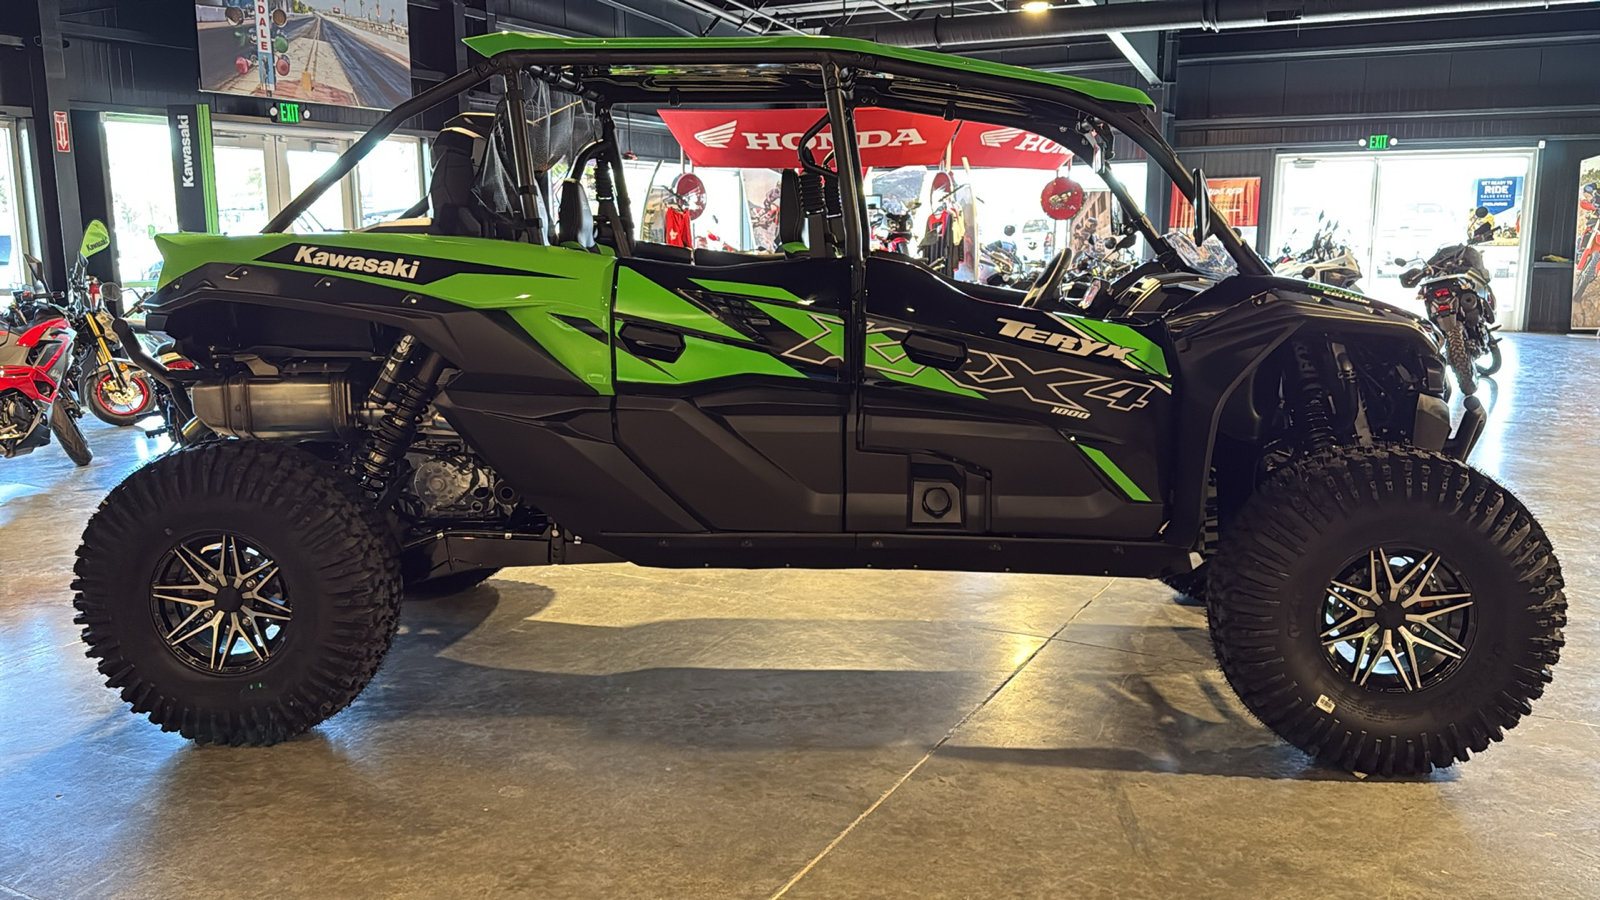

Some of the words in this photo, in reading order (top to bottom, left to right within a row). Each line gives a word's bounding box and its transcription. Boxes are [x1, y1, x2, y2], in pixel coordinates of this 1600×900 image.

[257, 0, 268, 51] DALE
[279, 102, 299, 123] EXIT
[177, 114, 195, 188] Kawasaki
[1369, 135, 1388, 149] EXIT
[1484, 185, 1509, 194] RIDE
[293, 245, 420, 280] Kawasaki
[1050, 406, 1091, 420] 1000
